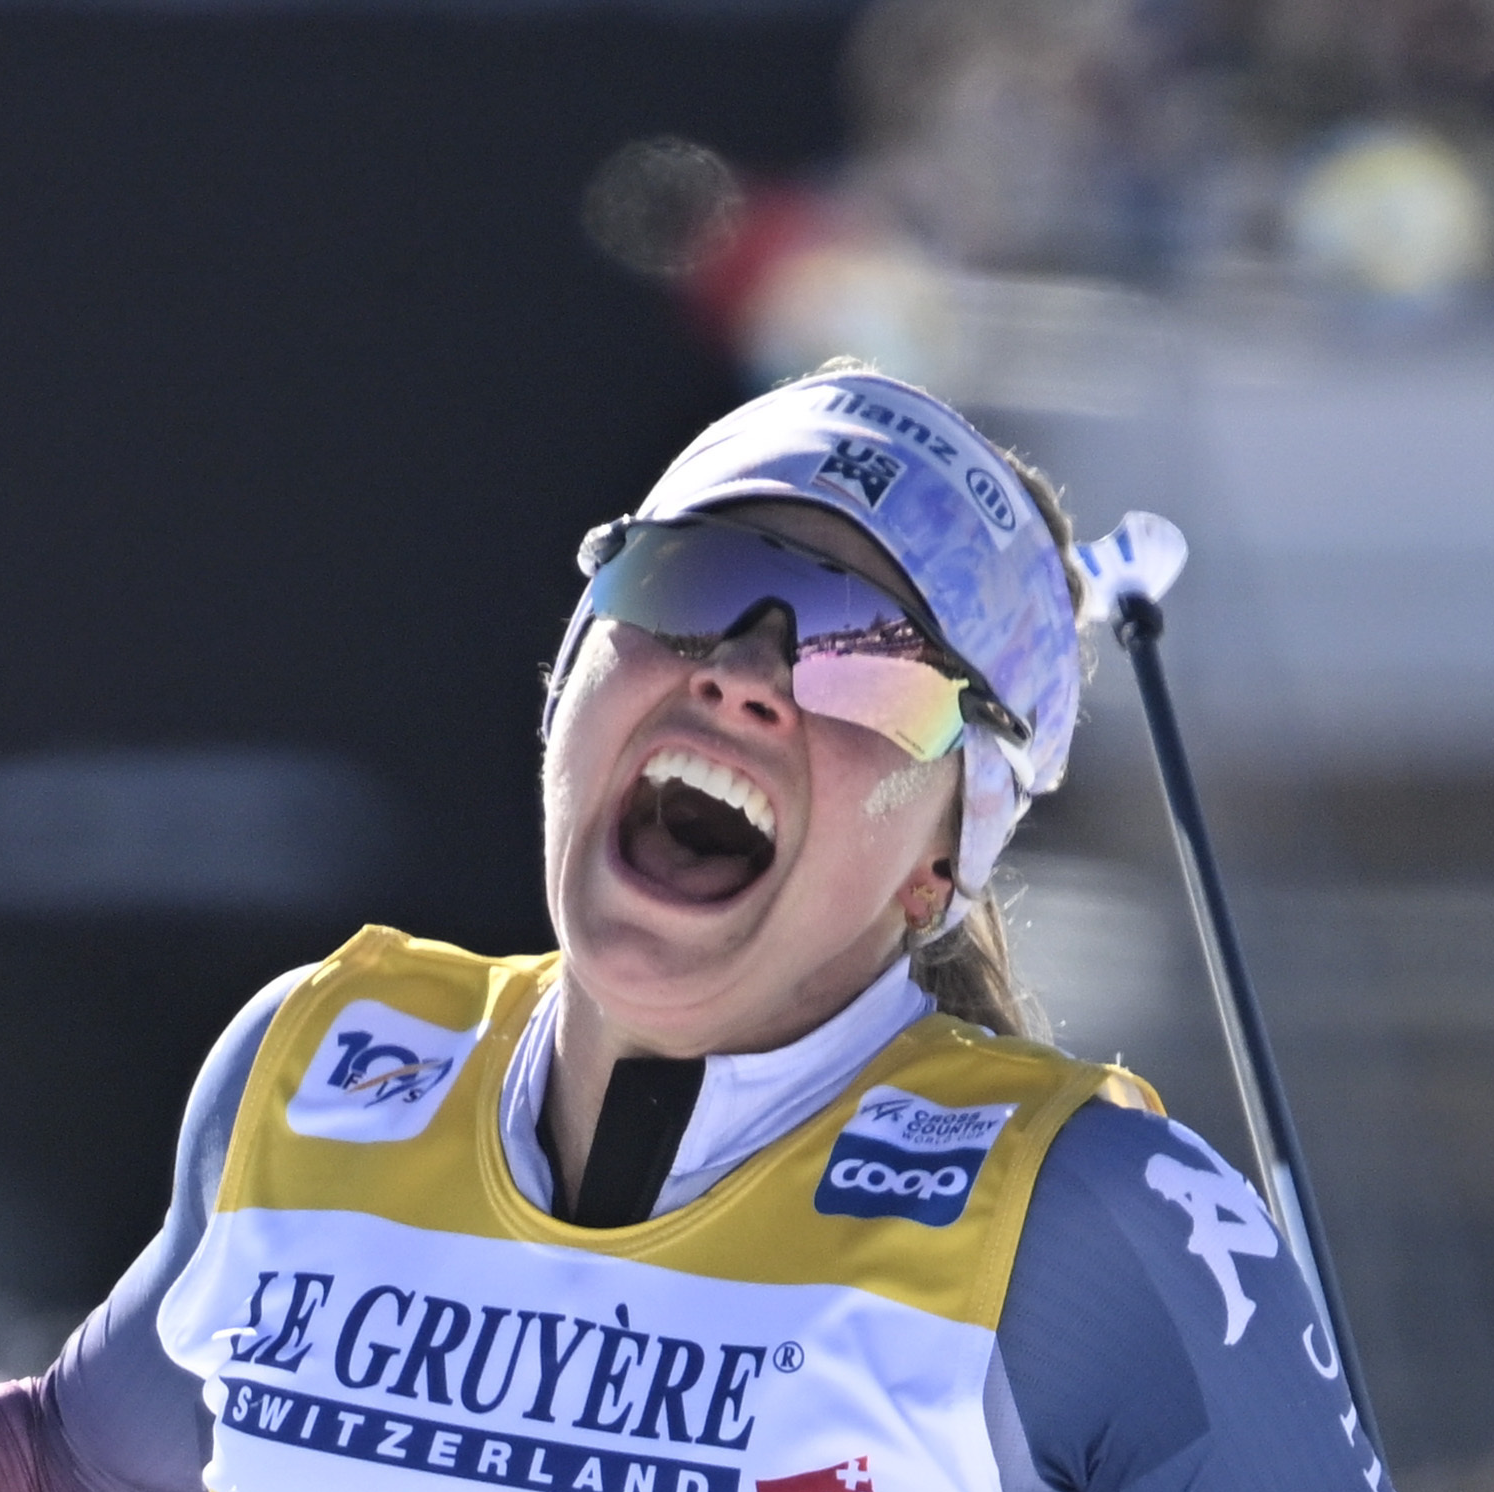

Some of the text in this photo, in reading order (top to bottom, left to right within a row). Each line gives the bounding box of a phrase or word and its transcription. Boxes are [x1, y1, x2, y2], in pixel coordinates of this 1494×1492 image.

[836, 439, 901, 479] US
[907, 1118, 1000, 1137] COUNTRY
[830, 1158, 969, 1201] coop
[230, 1271, 335, 1374] LE
